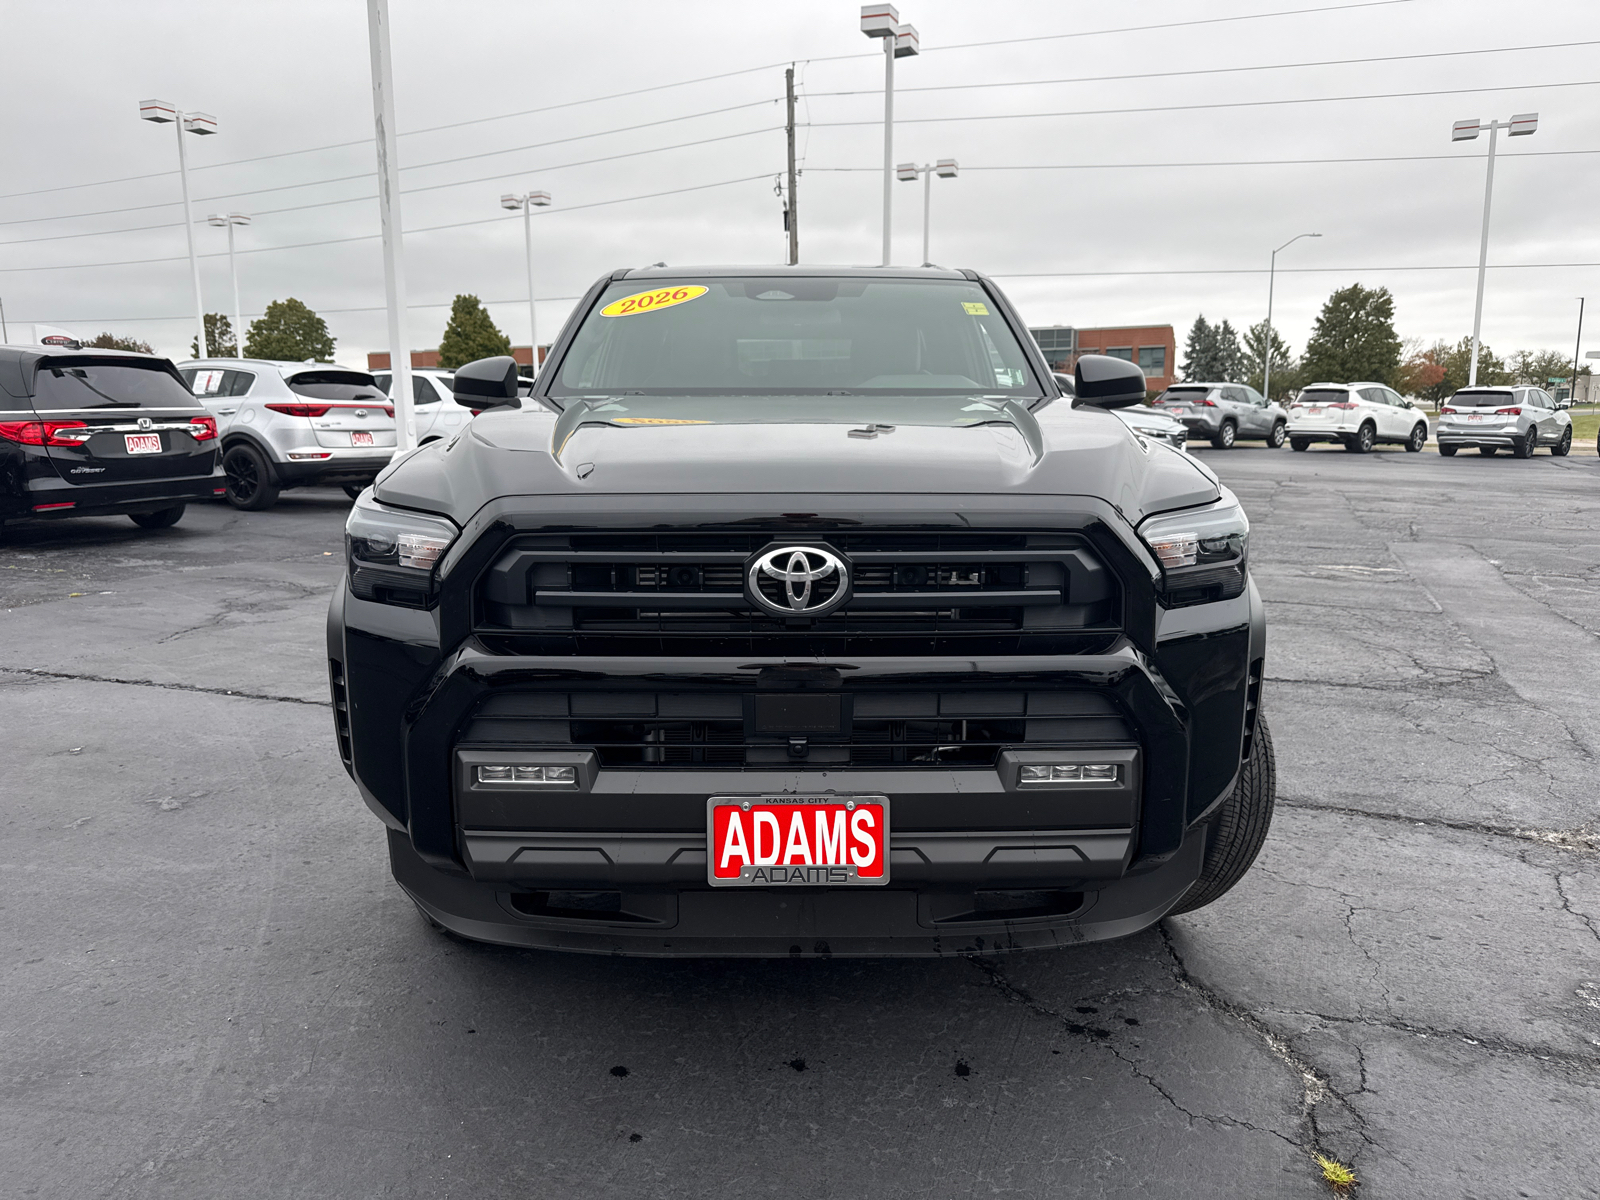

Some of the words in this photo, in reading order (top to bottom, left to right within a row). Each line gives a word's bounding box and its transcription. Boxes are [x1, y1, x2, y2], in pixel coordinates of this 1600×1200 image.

[620, 287, 689, 314] 2026
[129, 436, 159, 451] ADAMS
[720, 809, 876, 868] ADAMS
[751, 867, 848, 883] ADAMS
